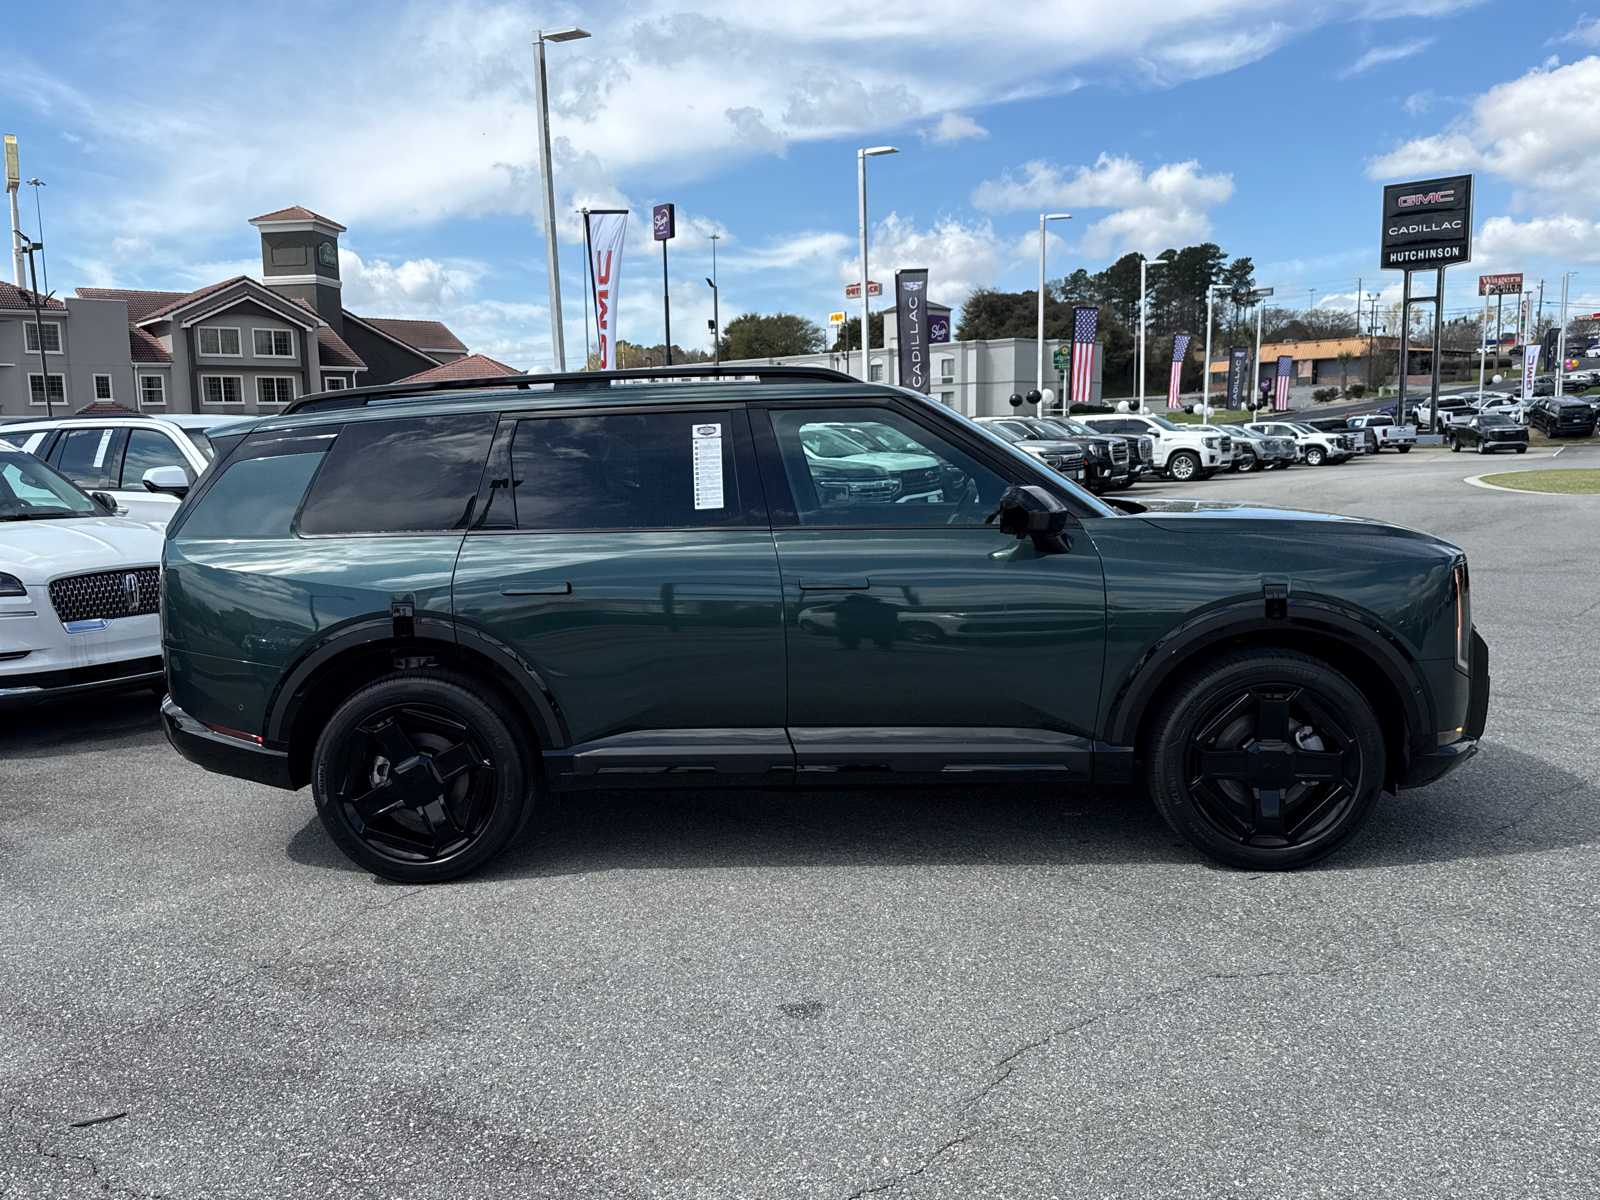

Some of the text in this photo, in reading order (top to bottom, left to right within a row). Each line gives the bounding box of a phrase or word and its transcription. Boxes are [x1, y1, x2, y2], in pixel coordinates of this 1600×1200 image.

[1398, 190, 1454, 207] GMC
[1388, 220, 1462, 235] CADILLAC
[1390, 246, 1459, 262] HUTCHINSON
[1481, 275, 1521, 285] Wagers
[846, 285, 879, 295] OUTCK
[908, 297, 922, 388] CADILLAC
[1526, 355, 1535, 390] GMC
[1232, 359, 1242, 407] CADILLAC
